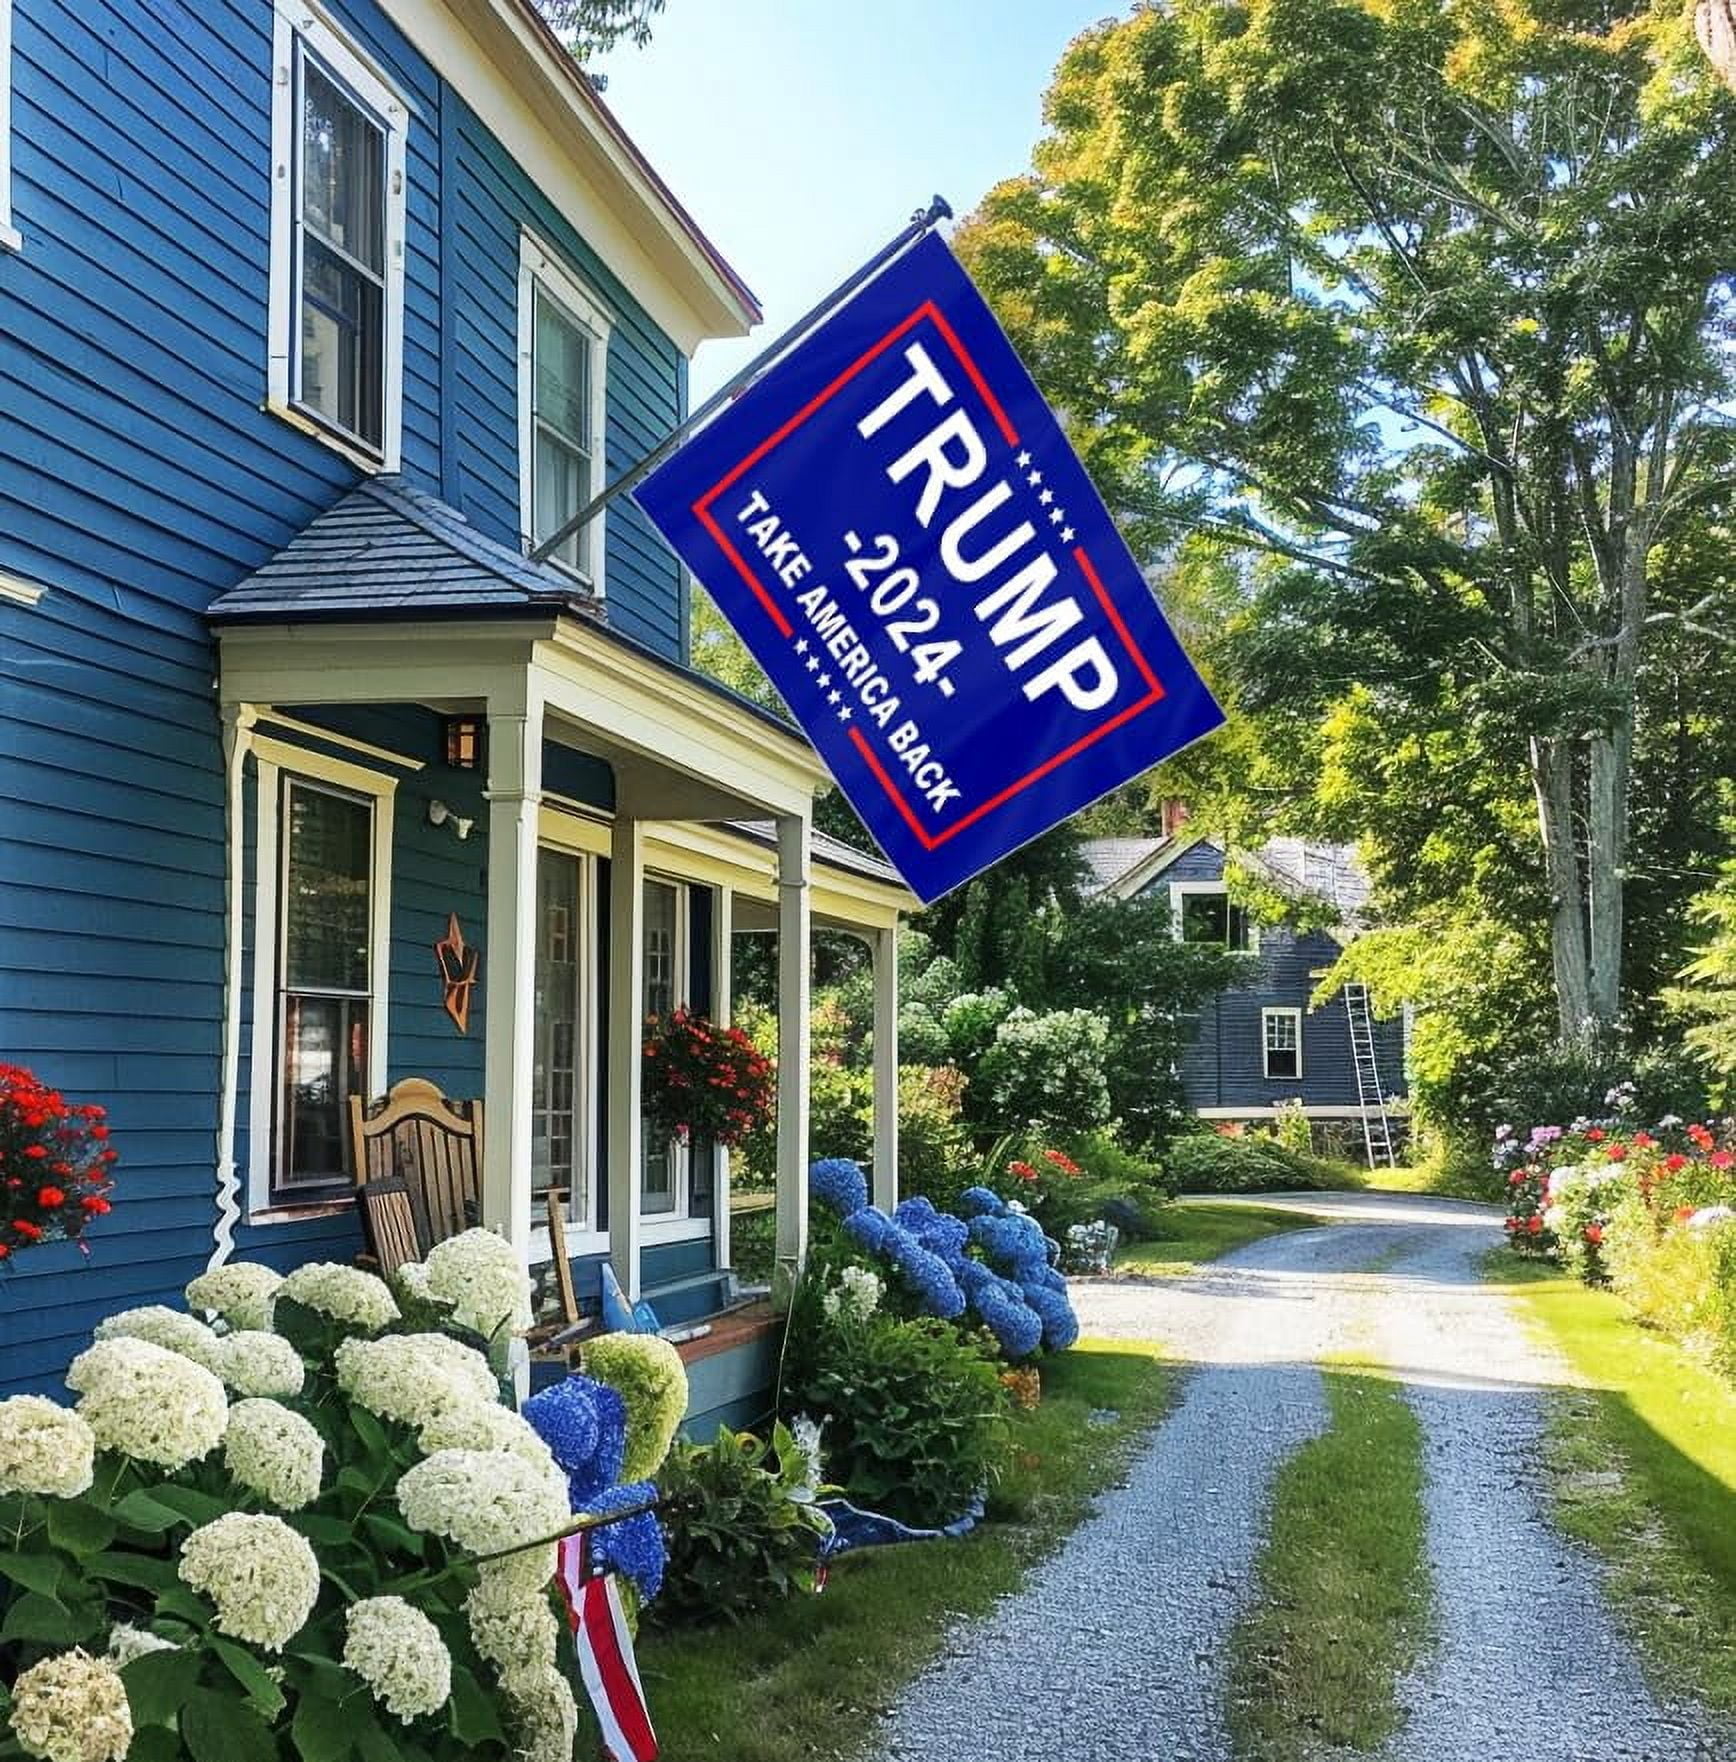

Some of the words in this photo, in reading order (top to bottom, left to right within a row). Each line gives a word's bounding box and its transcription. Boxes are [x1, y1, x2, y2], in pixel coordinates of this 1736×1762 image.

[737, 490, 812, 589] TAKE
[796, 585, 901, 729] AMERICA
[887, 719, 961, 813] BACK
[844, 530, 963, 698] -2024-
[857, 342, 1119, 711] TRUMP
